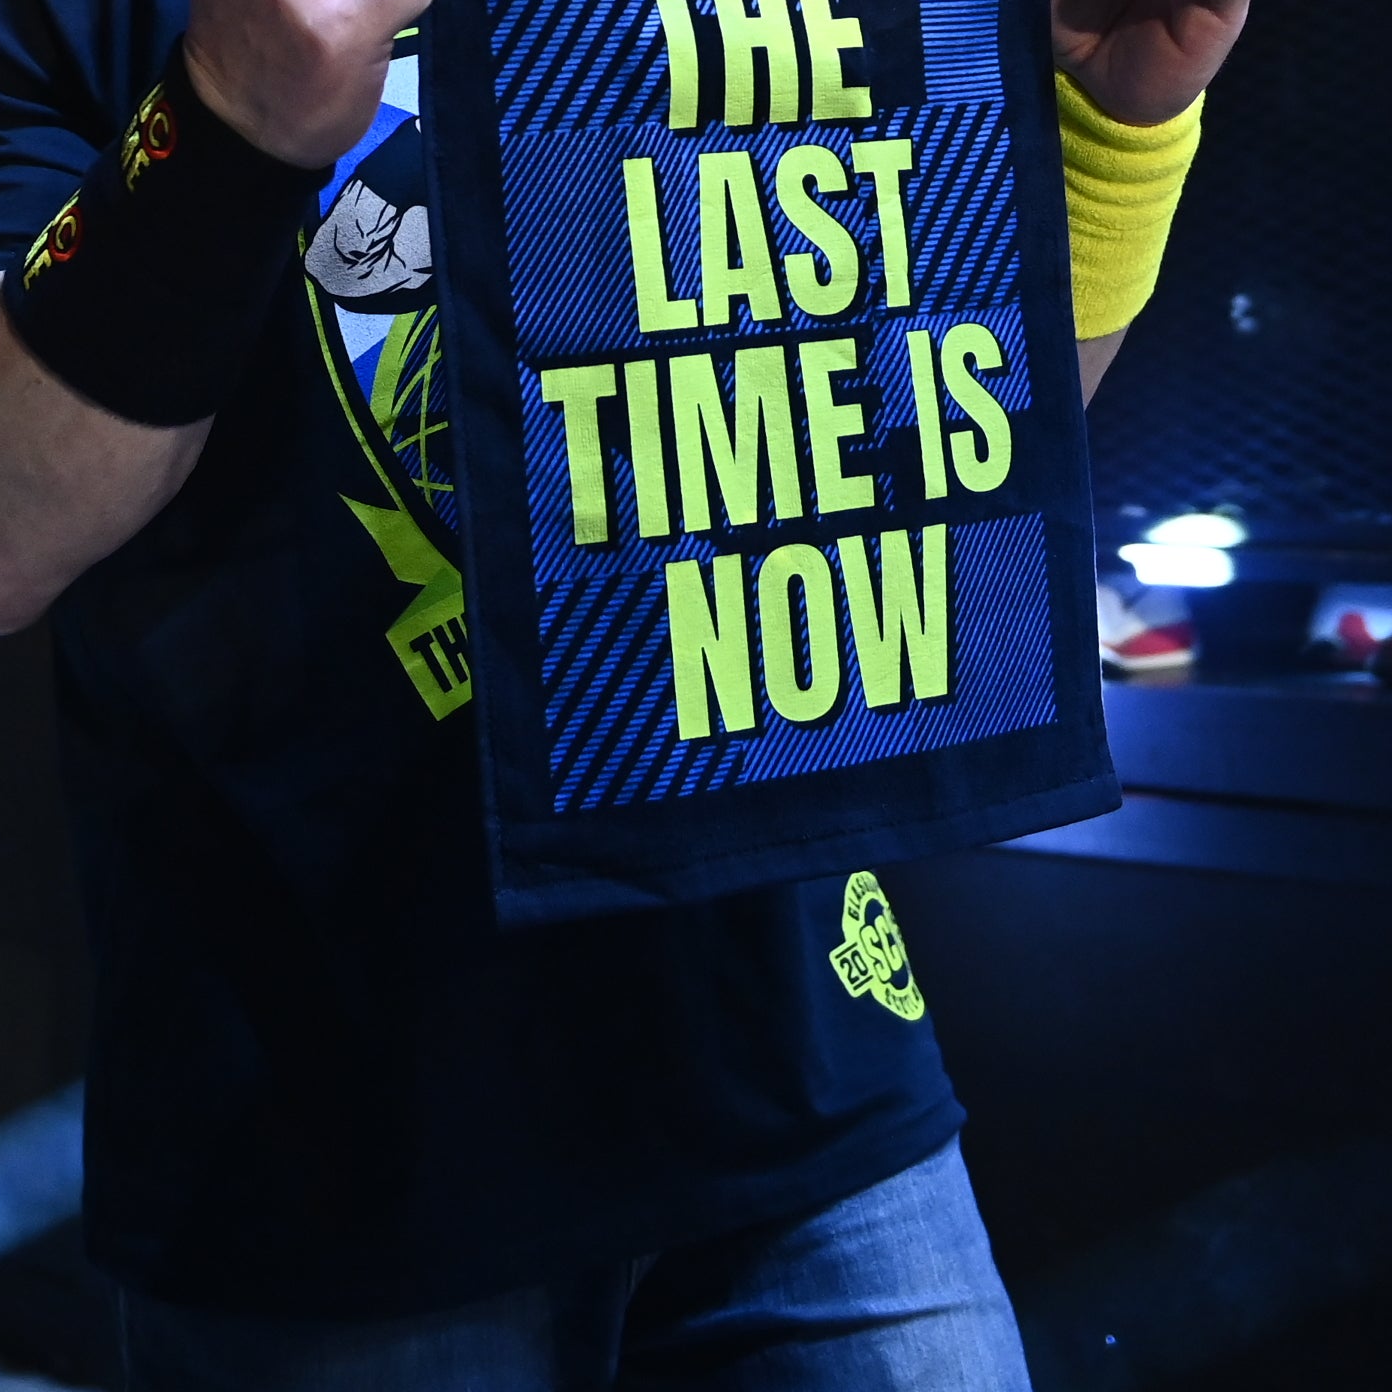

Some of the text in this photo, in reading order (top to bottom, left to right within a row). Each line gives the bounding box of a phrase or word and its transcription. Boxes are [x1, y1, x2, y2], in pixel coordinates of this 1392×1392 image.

[622, 138, 913, 333] LAST
[540, 323, 1013, 546] TIME IS
[665, 523, 948, 741] NOW
[839, 949, 869, 986] 20
